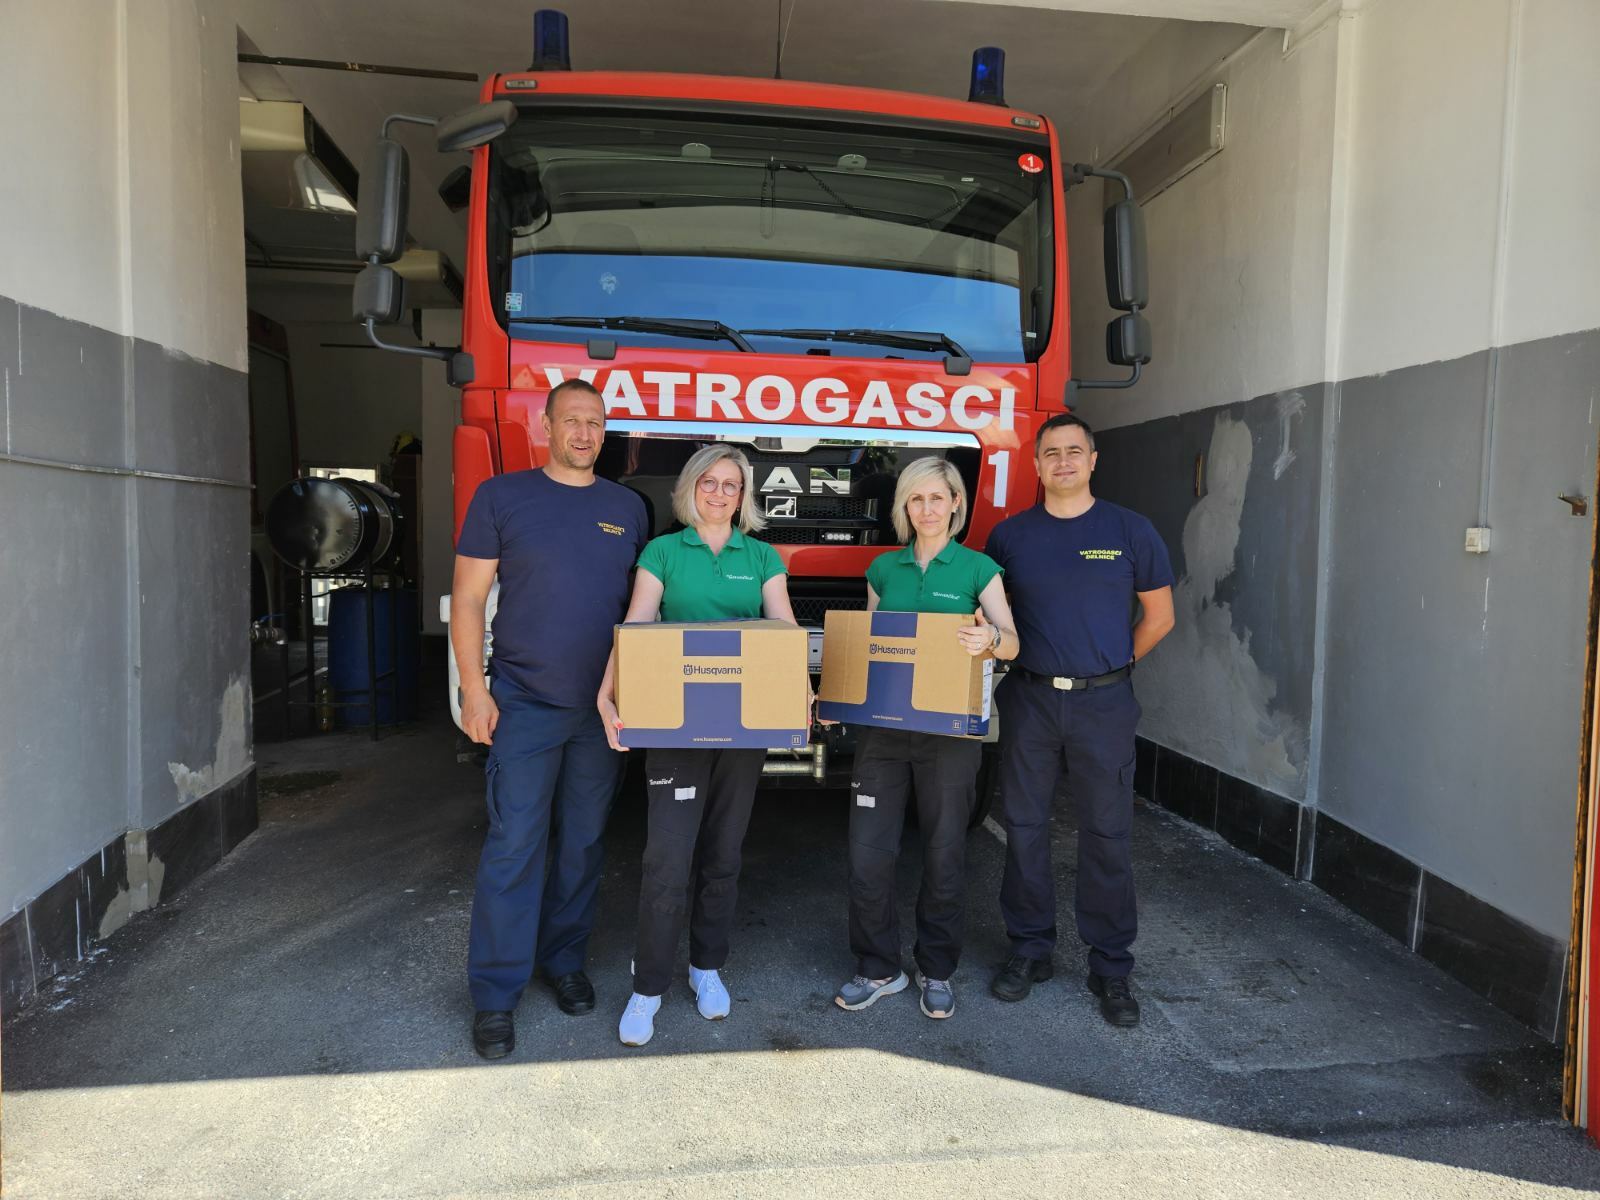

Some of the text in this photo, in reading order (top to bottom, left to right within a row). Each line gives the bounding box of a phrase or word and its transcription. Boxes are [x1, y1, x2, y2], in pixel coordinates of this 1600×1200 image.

[1027, 155, 1034, 167] 1
[747, 465, 851, 495] AN
[988, 450, 1010, 507] 1
[877, 645, 916, 656] Husqvarna
[693, 665, 742, 676] Husqvarna
